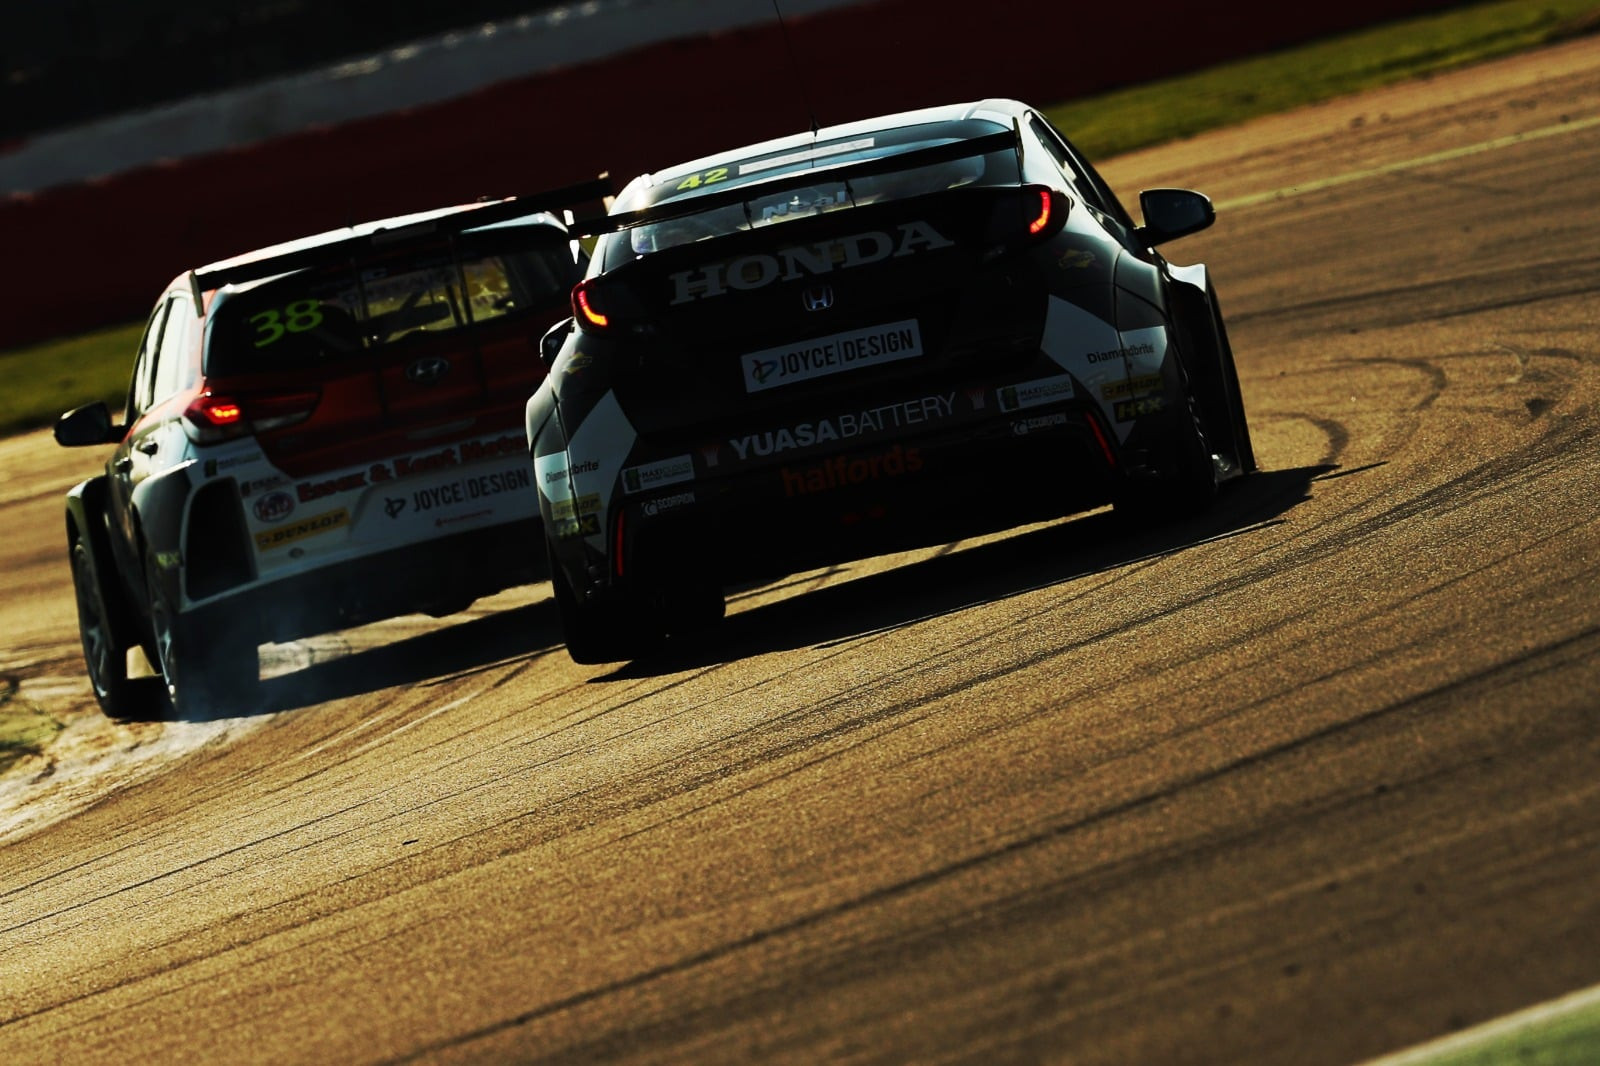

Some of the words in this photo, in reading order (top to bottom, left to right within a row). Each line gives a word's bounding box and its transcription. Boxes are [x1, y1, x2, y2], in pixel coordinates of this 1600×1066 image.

[676, 167, 729, 191] 42
[669, 219, 955, 306] HONDA
[250, 298, 325, 349] 38
[393, 448, 456, 478] Kent
[780, 443, 926, 497] halfords
[273, 511, 345, 542] DUNLOP
